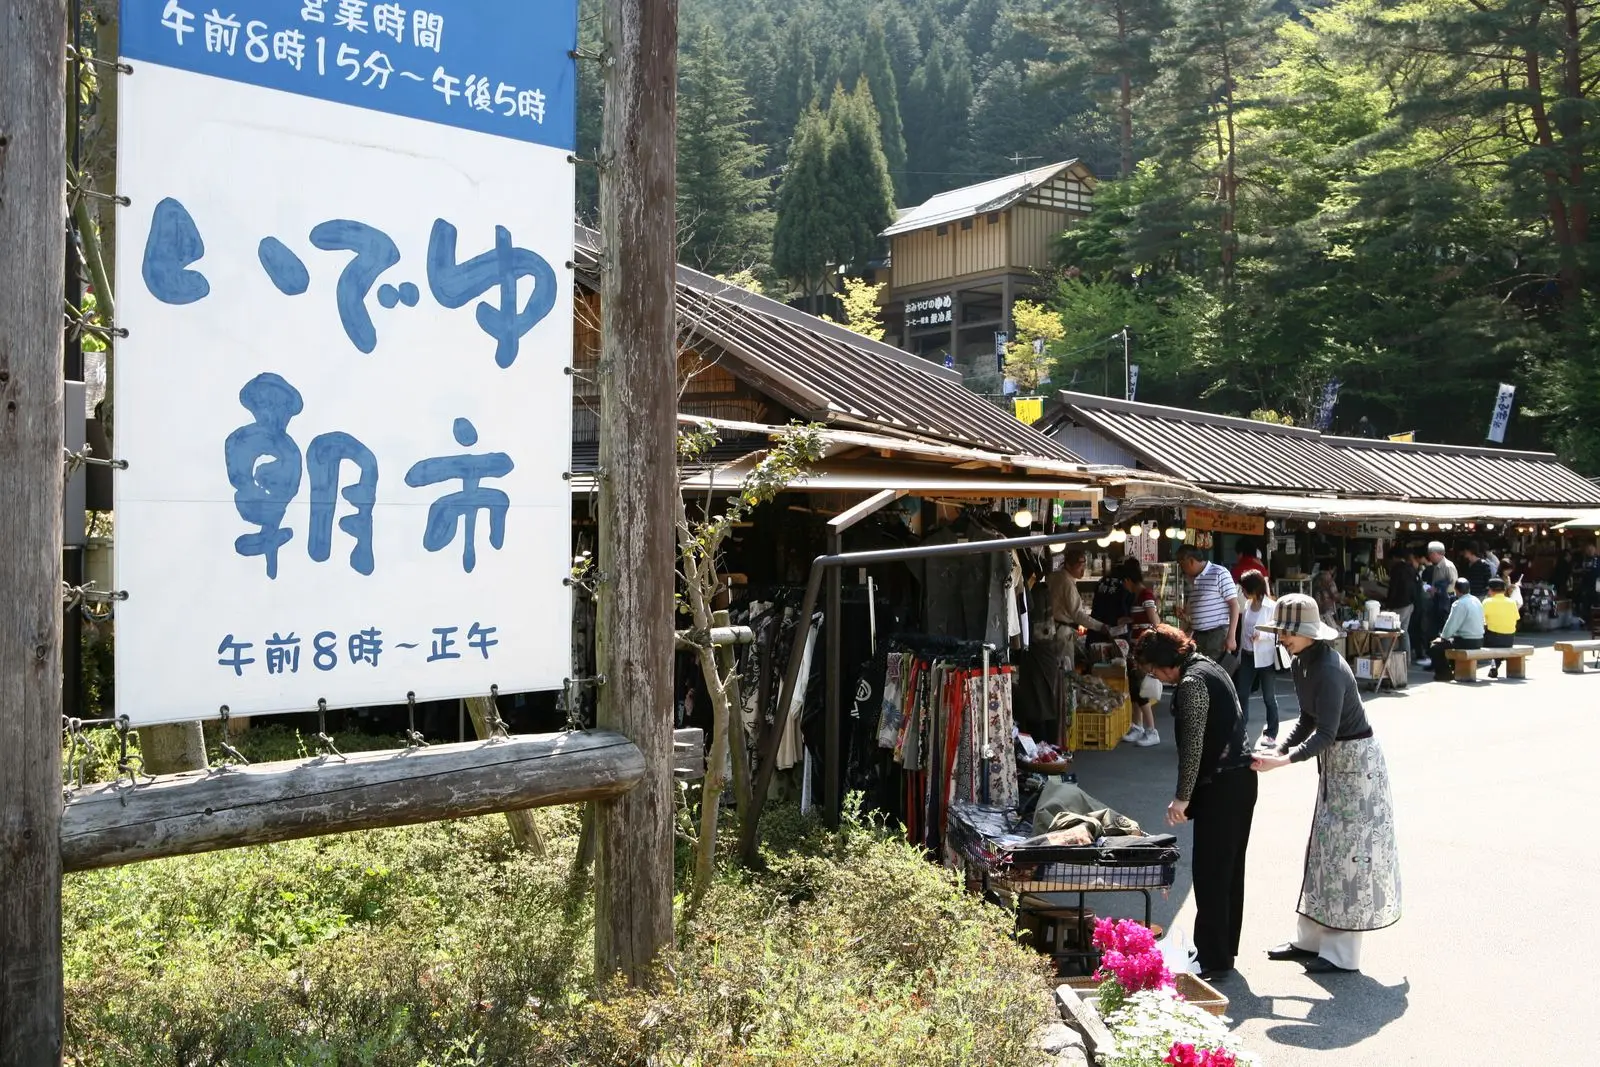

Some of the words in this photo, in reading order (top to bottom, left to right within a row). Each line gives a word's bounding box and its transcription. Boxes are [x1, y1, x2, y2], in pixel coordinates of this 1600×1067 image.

[301, 0, 444, 53] 営業時間
[142, 196, 557, 369] いでゆ
[225, 372, 514, 579] 朝市
